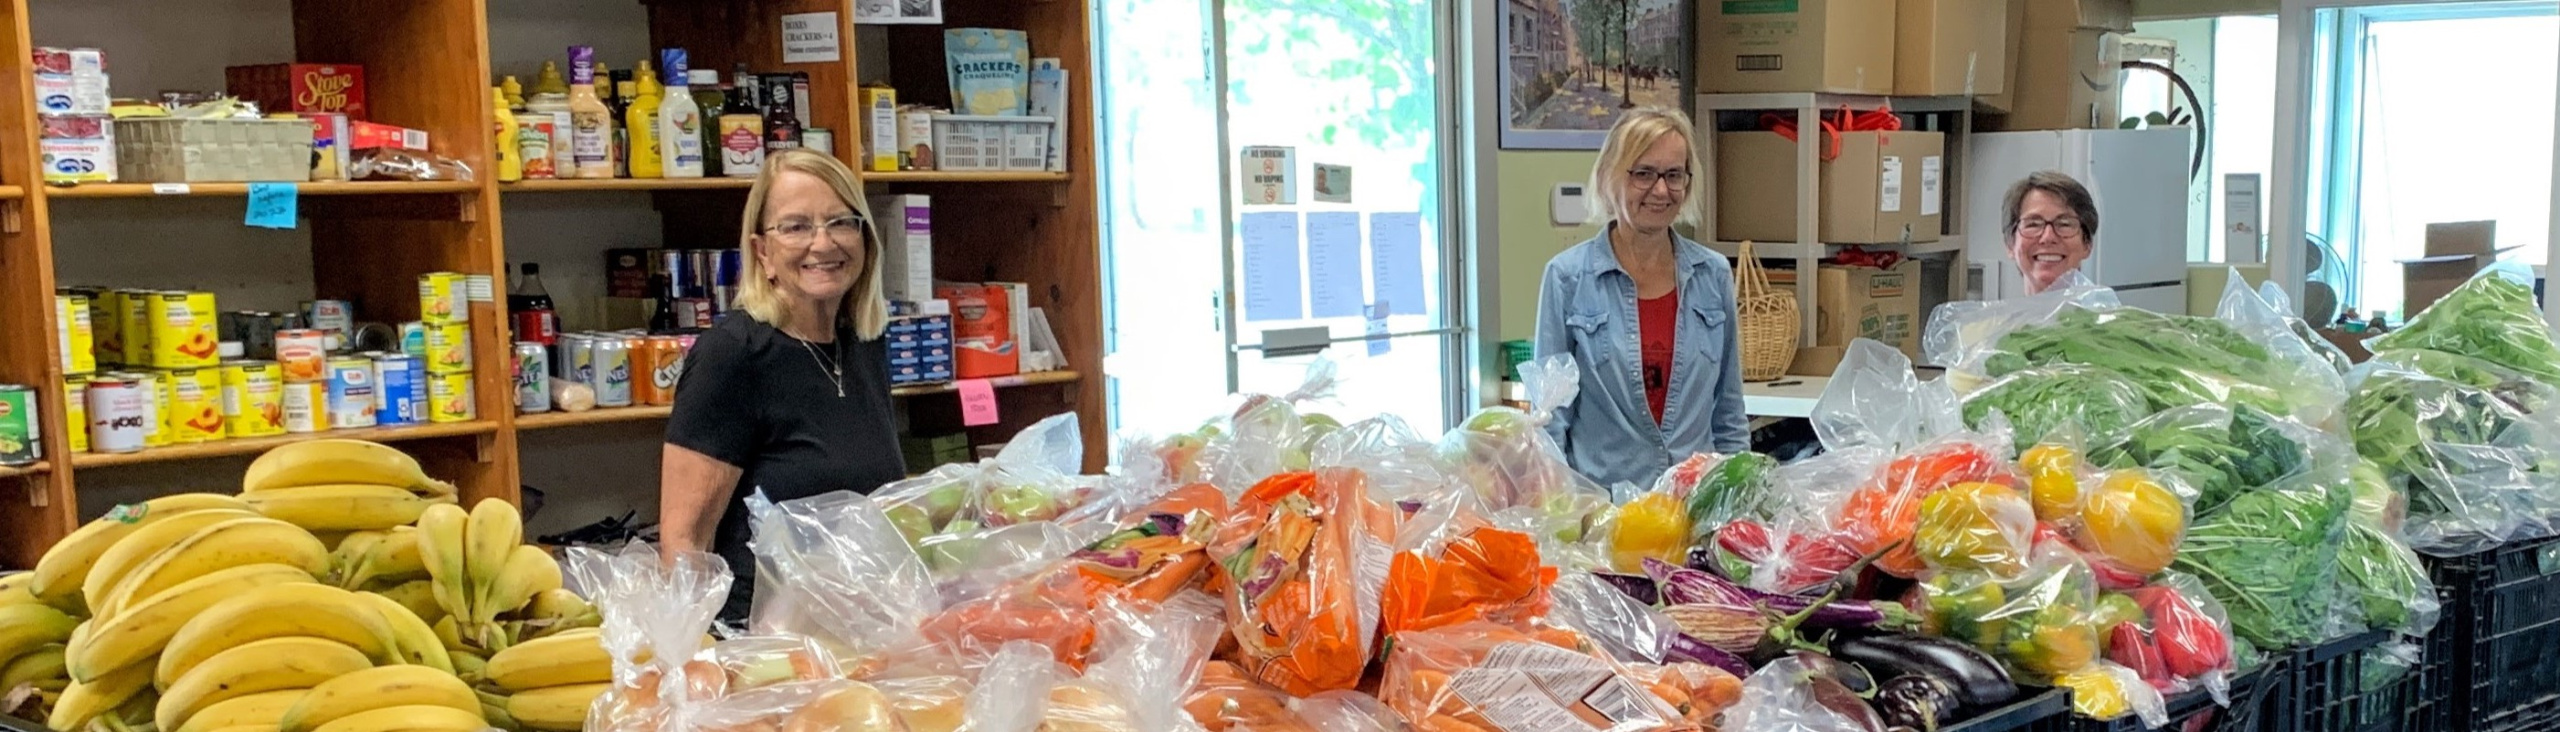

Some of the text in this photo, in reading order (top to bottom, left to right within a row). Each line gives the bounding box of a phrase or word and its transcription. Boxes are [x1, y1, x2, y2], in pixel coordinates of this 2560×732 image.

[785, 32, 822, 42] CRACKERS
[955, 61, 1021, 74] CRACKERS
[298, 71, 354, 106] Stove
[320, 93, 347, 113] Top
[1260, 149, 1286, 159] SMOKING
[1254, 174, 1284, 184] NO VAPING
[653, 355, 684, 389] Cru
